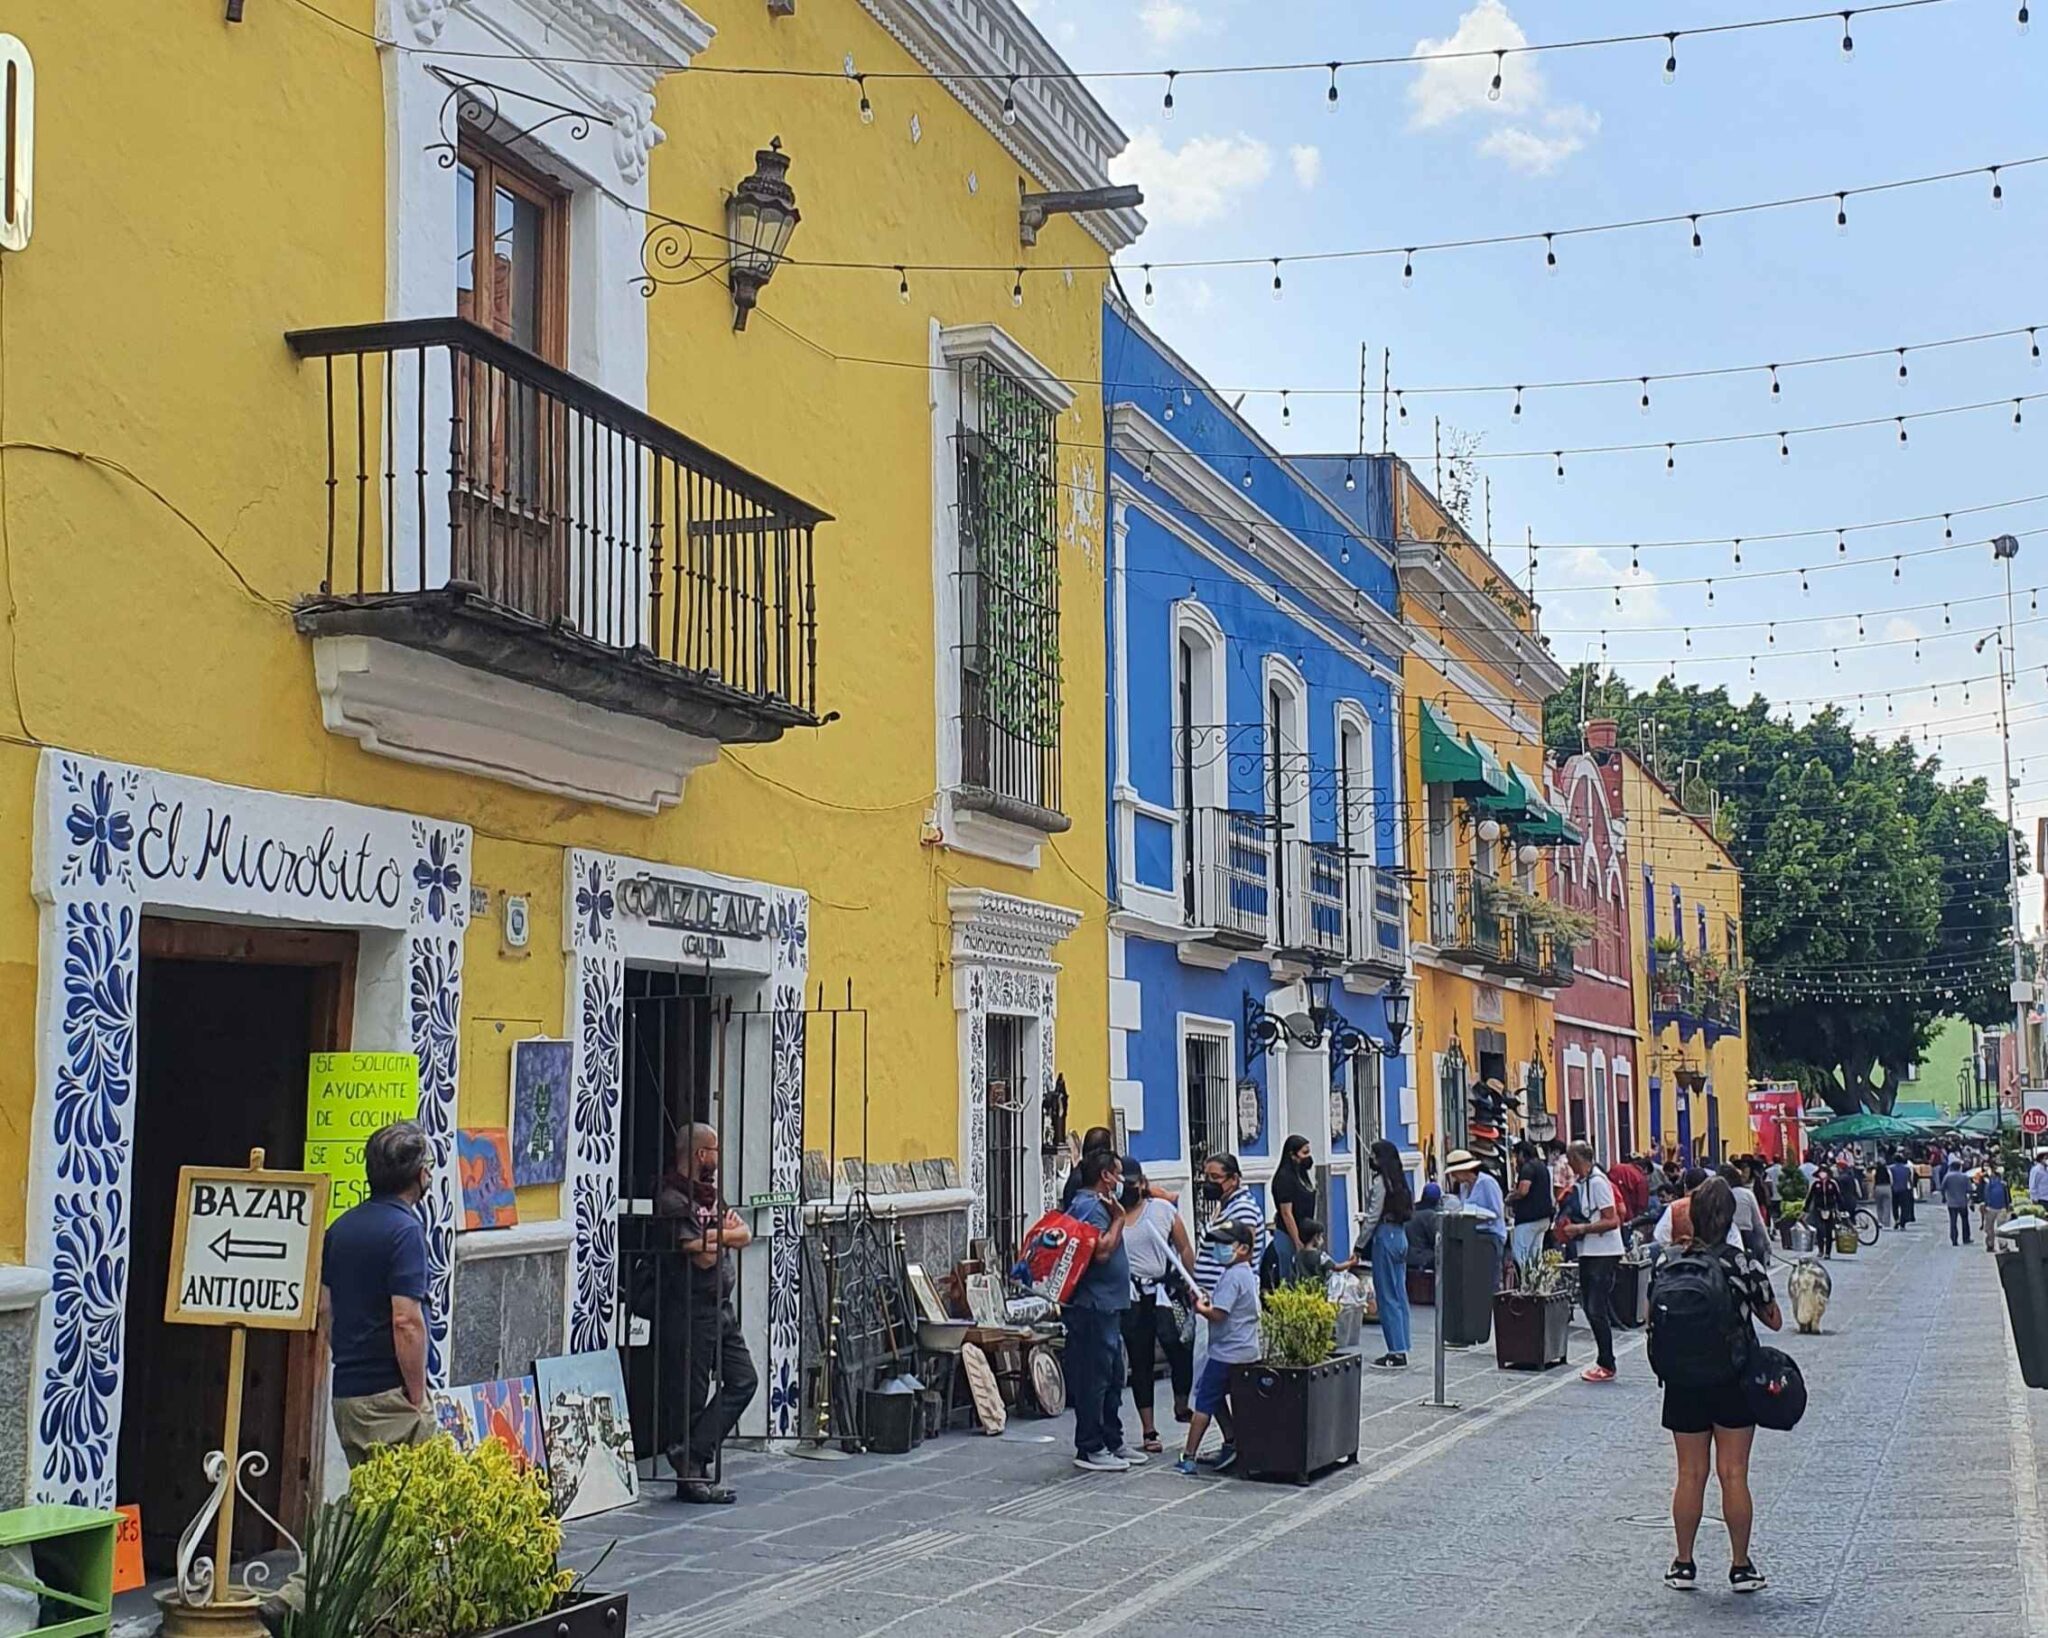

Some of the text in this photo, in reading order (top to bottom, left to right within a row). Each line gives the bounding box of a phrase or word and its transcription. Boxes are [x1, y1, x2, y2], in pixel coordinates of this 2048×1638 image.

[138, 786, 402, 908] El Microbito
[316, 1055, 412, 1073] SE SOLICITA
[322, 1082, 408, 1099] AYUDANTE
[316, 1110, 333, 1126] DE
[2025, 1112, 2046, 1126] ALTO
[310, 1146, 328, 1164] SE
[193, 1185, 309, 1226] BAZAR
[752, 1193, 793, 1205] SALIDA
[181, 1275, 300, 1312] ANTIQUES
